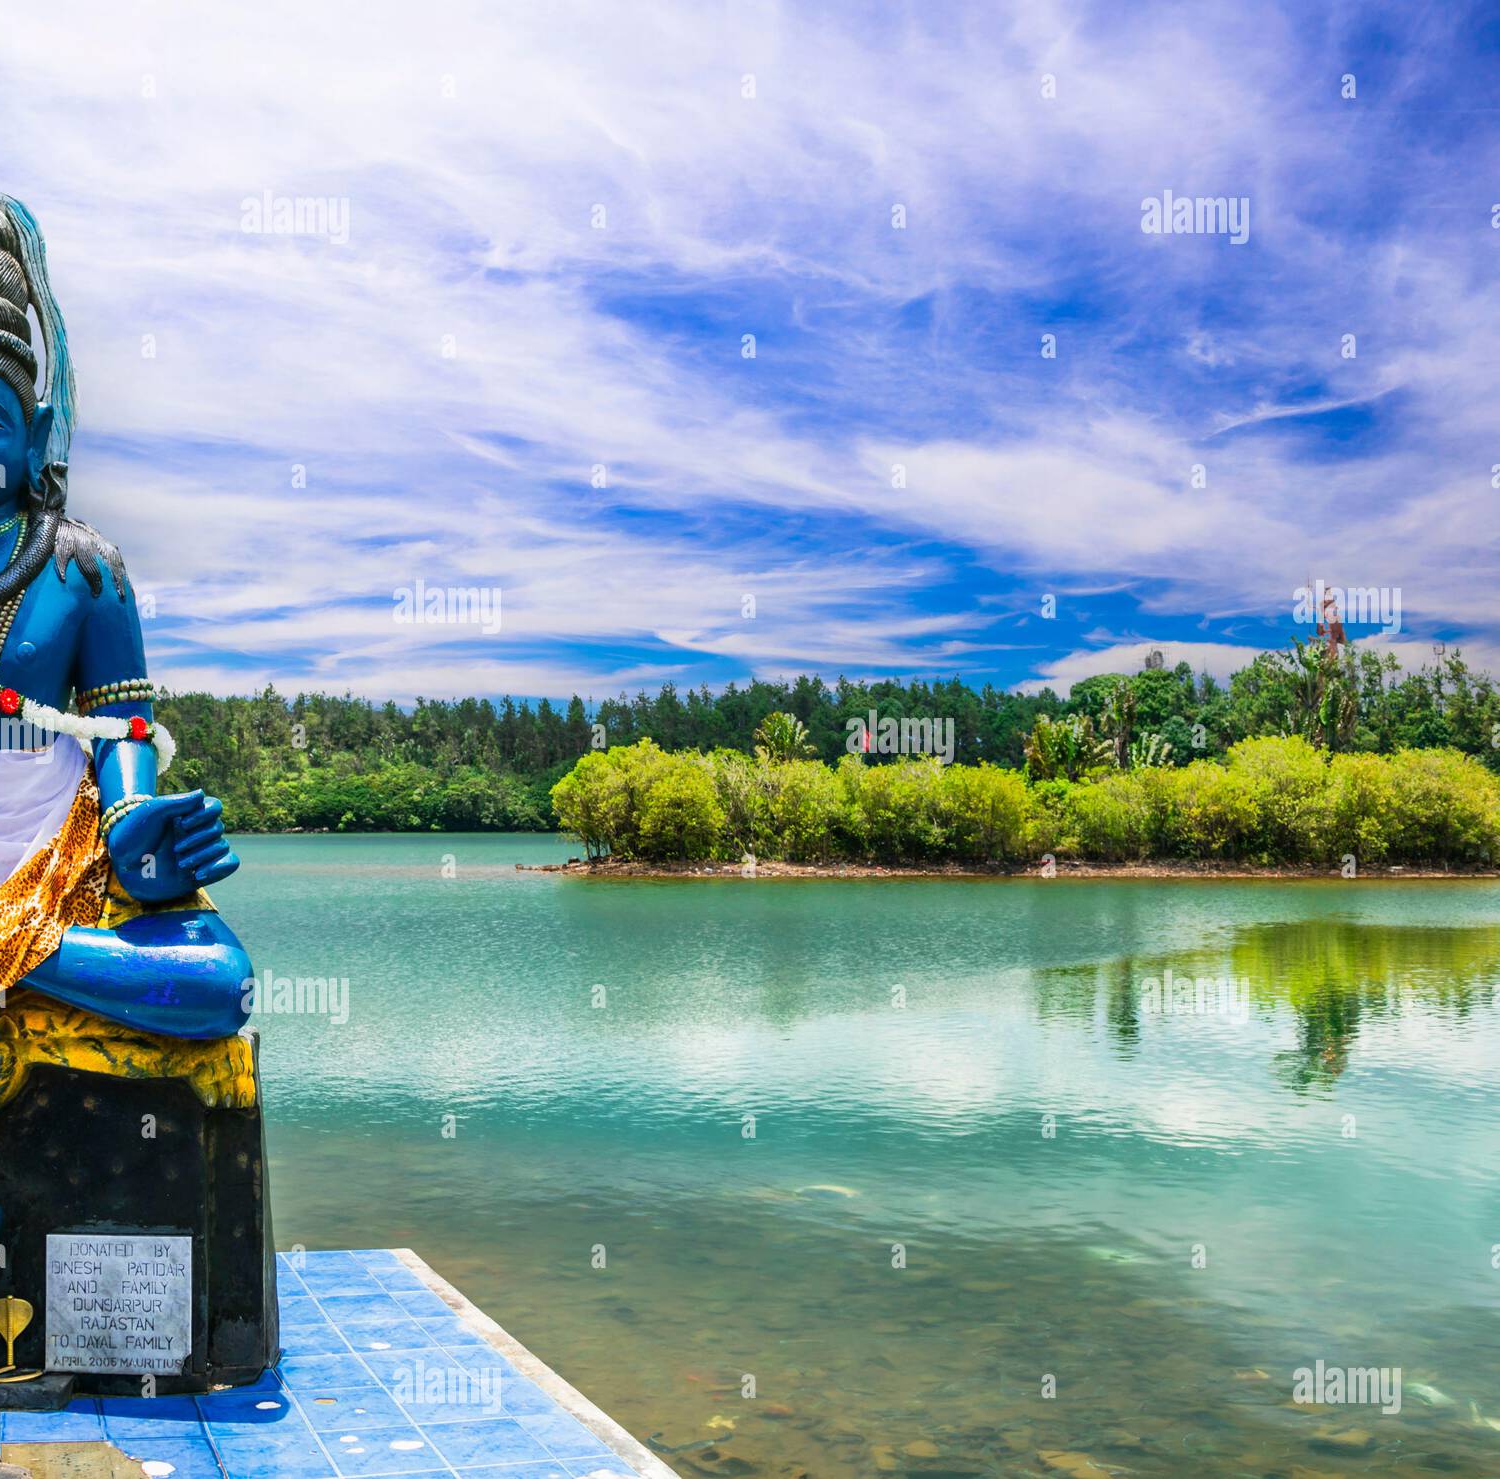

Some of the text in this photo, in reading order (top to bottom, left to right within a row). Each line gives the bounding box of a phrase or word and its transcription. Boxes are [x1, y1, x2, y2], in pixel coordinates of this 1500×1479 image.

[70, 1242, 172, 1258] DONATED BY
[51, 1261, 186, 1277] DINESH PATIDAR
[67, 1280, 168, 1295] AND FAMILY
[80, 1315, 155, 1331] RAJASTAN
[52, 1334, 174, 1350] TO DAYAL FAMILY
[53, 1356, 87, 1367] APRIL
[119, 1357, 183, 1369] MAURITIUS
